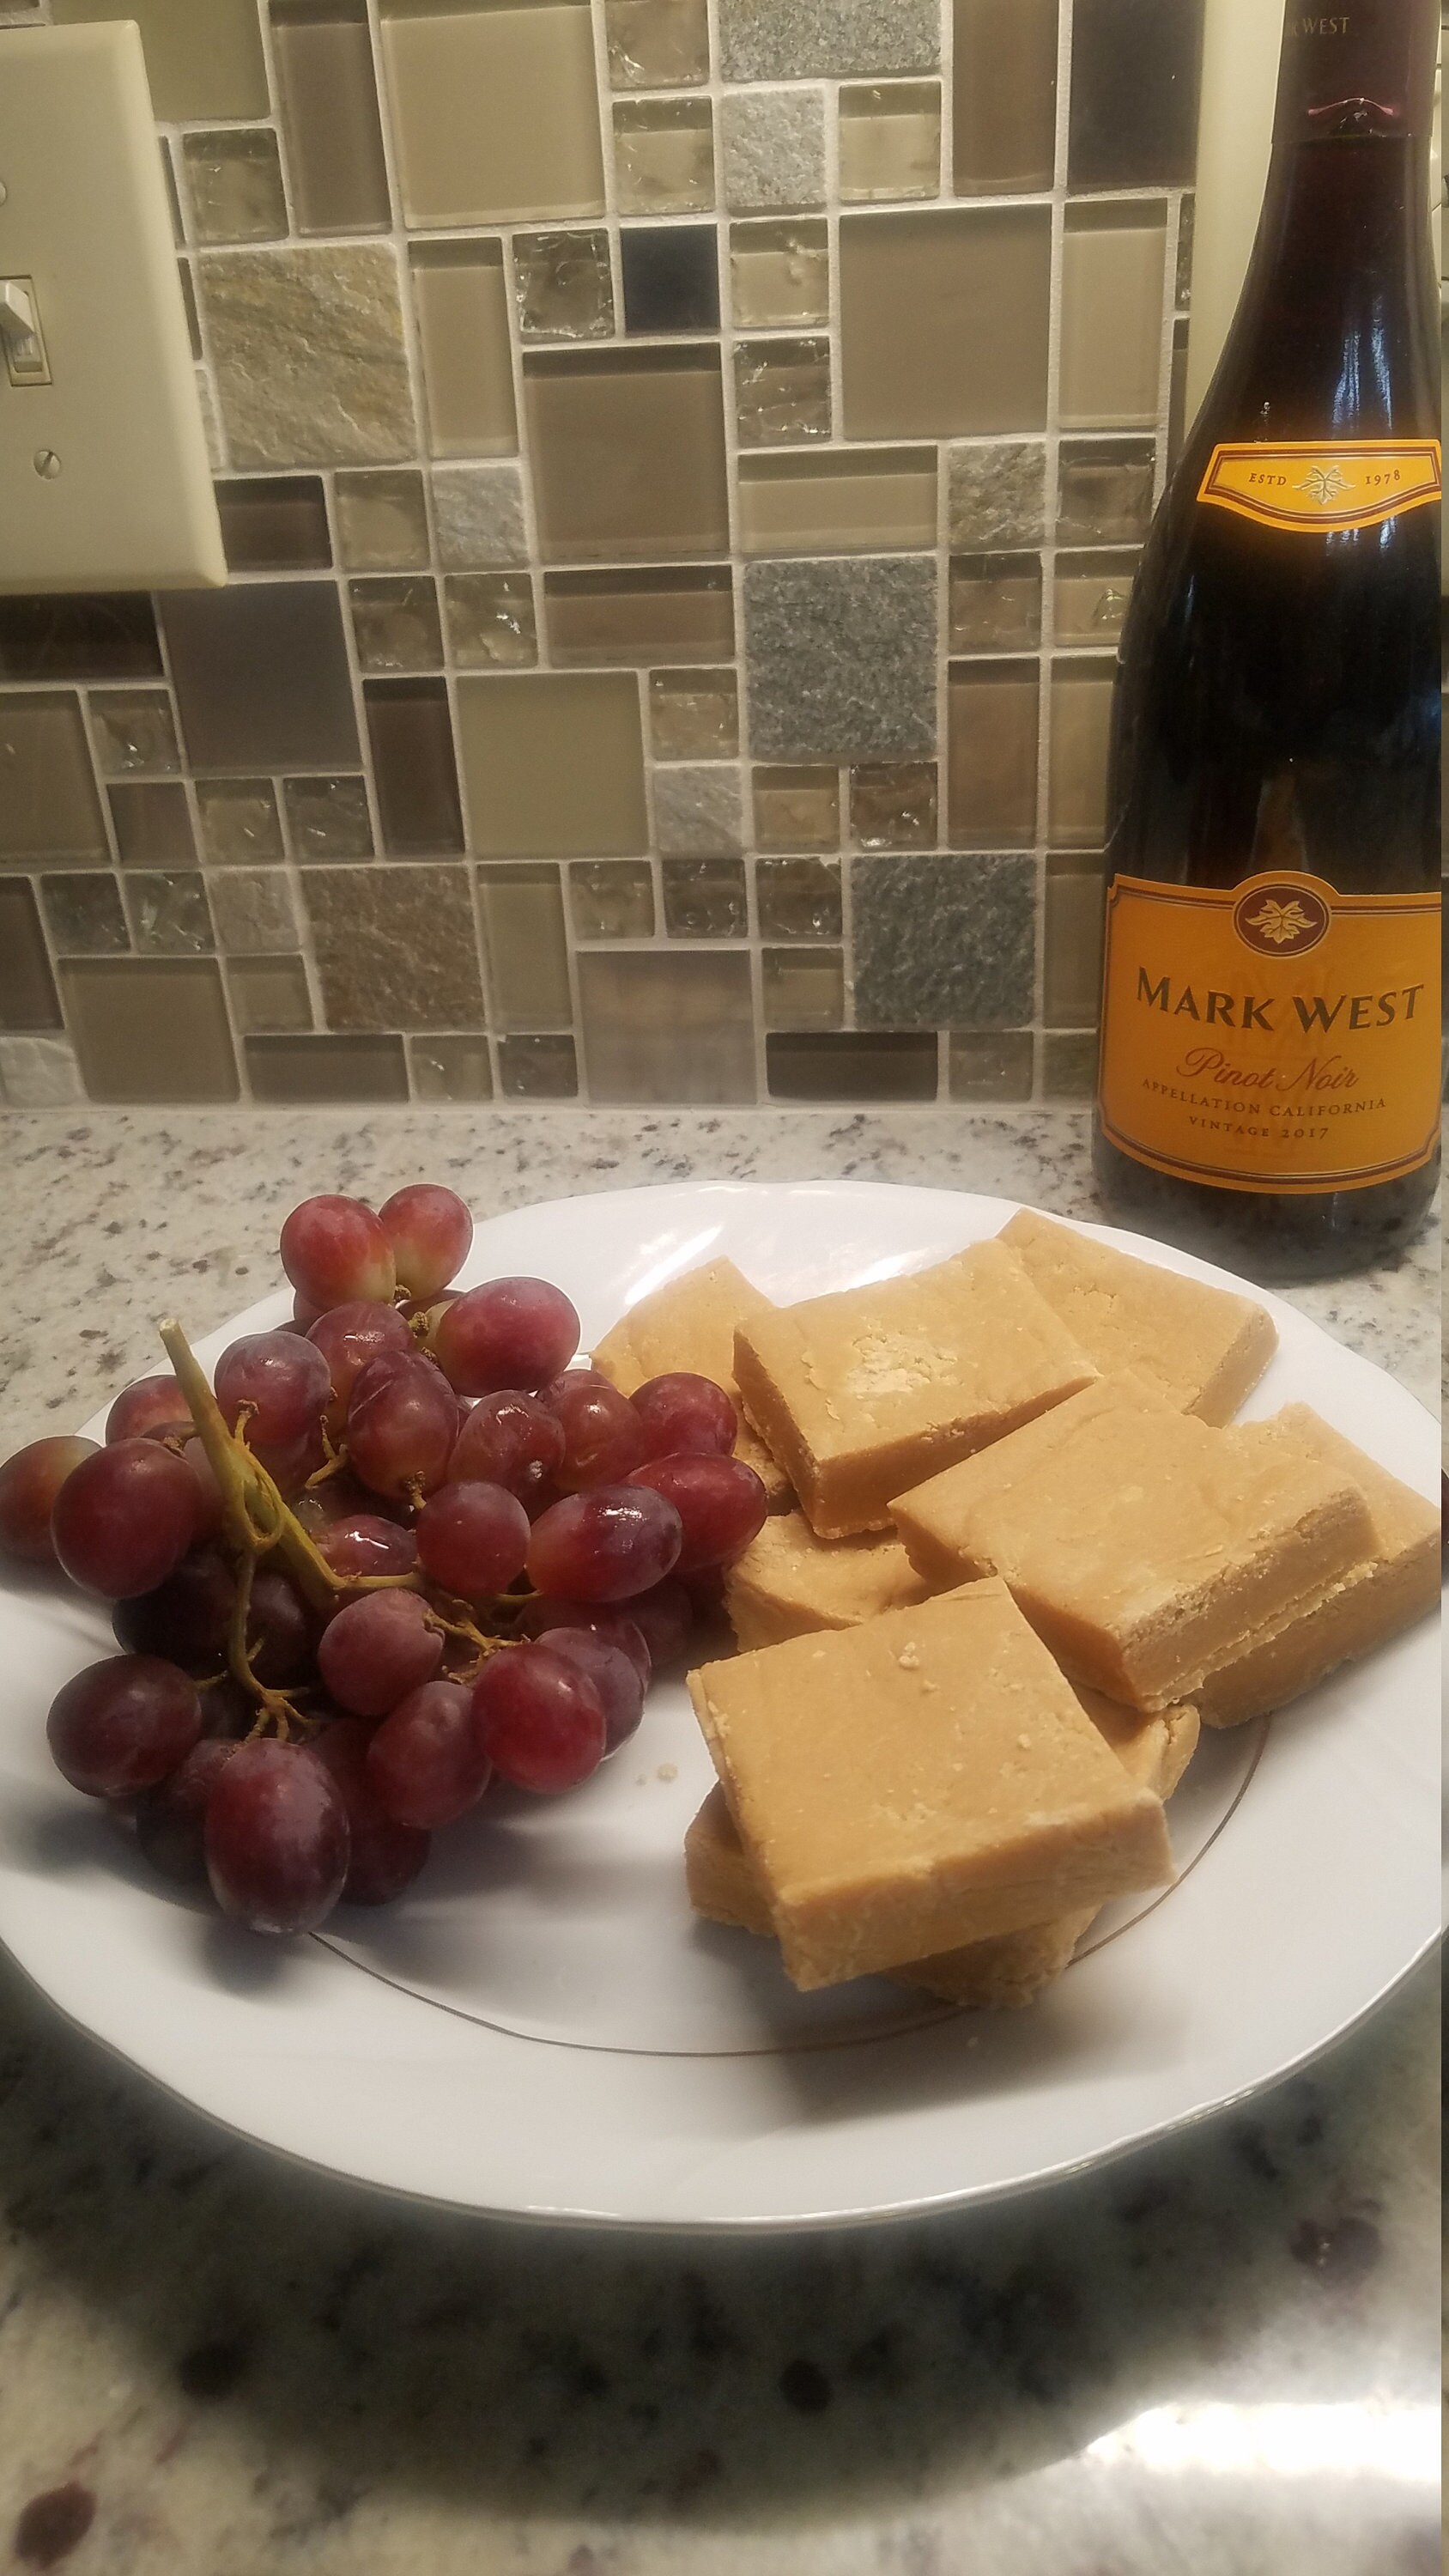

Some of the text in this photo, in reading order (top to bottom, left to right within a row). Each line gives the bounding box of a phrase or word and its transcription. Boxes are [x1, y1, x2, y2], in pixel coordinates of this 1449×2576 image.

[1302, 16, 1350, 35] WEST
[1249, 470, 1401, 486] ESTD 1978
[1137, 965, 1425, 1033] MARK WEST
[1176, 1047, 1359, 1091] Pinot Noir
[1143, 1078, 1386, 1116] APPELLATION CALIFORNIA
[1188, 1115, 1329, 1139] VINTAGE 2017
